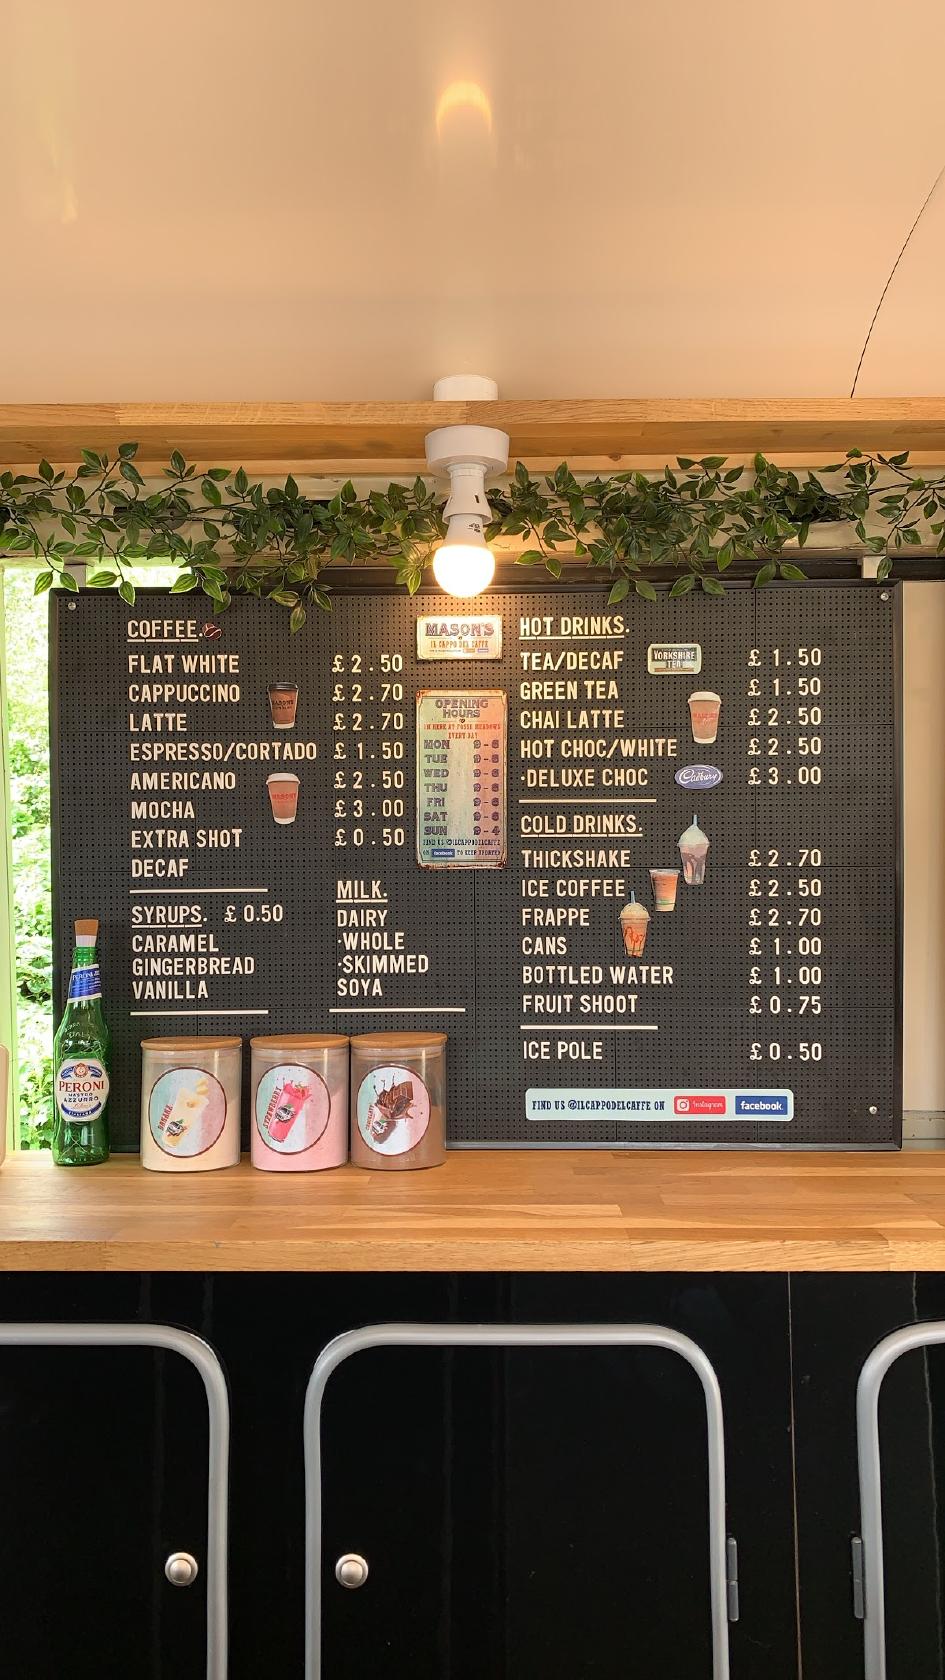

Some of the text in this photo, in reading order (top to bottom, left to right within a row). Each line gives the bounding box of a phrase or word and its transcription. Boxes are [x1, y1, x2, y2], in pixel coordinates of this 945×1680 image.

[128, 620, 202, 640] COFFEE.
[426, 623, 494, 636] MASON'S
[519, 616, 629, 638] HOT DRINKS.
[129, 655, 239, 673] FLAT WHITE
[520, 651, 623, 670] TEA/DECAF
[654, 651, 695, 660] YORKSHIRE
[129, 685, 239, 702] CAPPUCCINO
[521, 681, 618, 700] GREEN TEA
[435, 700, 488, 708] OPENING
[130, 713, 187, 731] LATTE
[443, 710, 480, 718] HOURS
[521, 710, 624, 728] CHAI LATTE
[131, 743, 316, 761] ESPRESSO/CORTADO
[424, 740, 450, 749] MON
[521, 739, 677, 758] HOT CHOC/WHITE
[425, 755, 447, 763] TUE
[131, 772, 235, 790] AMERICANO
[424, 769, 449, 777] WED
[603, 768, 647, 786] CHOC
[679, 769, 717, 783] Cadbury
[424, 784, 447, 792] THU
[132, 801, 194, 819] MOCHA
[427, 798, 444, 807] FRI
[424, 812, 448, 821] SAT
[521, 815, 643, 836] COLD DRINKS.
[132, 829, 242, 848] EXTRA SHOT
[424, 826, 447, 835] SUN
[132, 859, 188, 877] DECAF
[522, 850, 630, 868] THICKSHAKE
[338, 880, 387, 900] MILK.
[522, 880, 625, 897] ICE COFFEE
[132, 905, 207, 925] SYRUPS.
[338, 909, 387, 927] DAIRY
[522, 908, 589, 926] FRAPPE
[133, 934, 219, 952] CARAMEL
[523, 937, 566, 955] CANS
[133, 957, 254, 976] GINGERBREAD
[523, 966, 673, 984] BOTTLED WATER
[133, 981, 208, 999] VANILLA
[337, 978, 382, 996] SOYA
[523, 995, 637, 1013] FRUIT SHOOT
[524, 1041, 602, 1059] ICE POLE
[59, 1081, 104, 1092] PERONI
[533, 1100, 665, 1111] FIND US @ILCAPPODELCAFFE ON
[693, 1100, 723, 1109] Instagram
